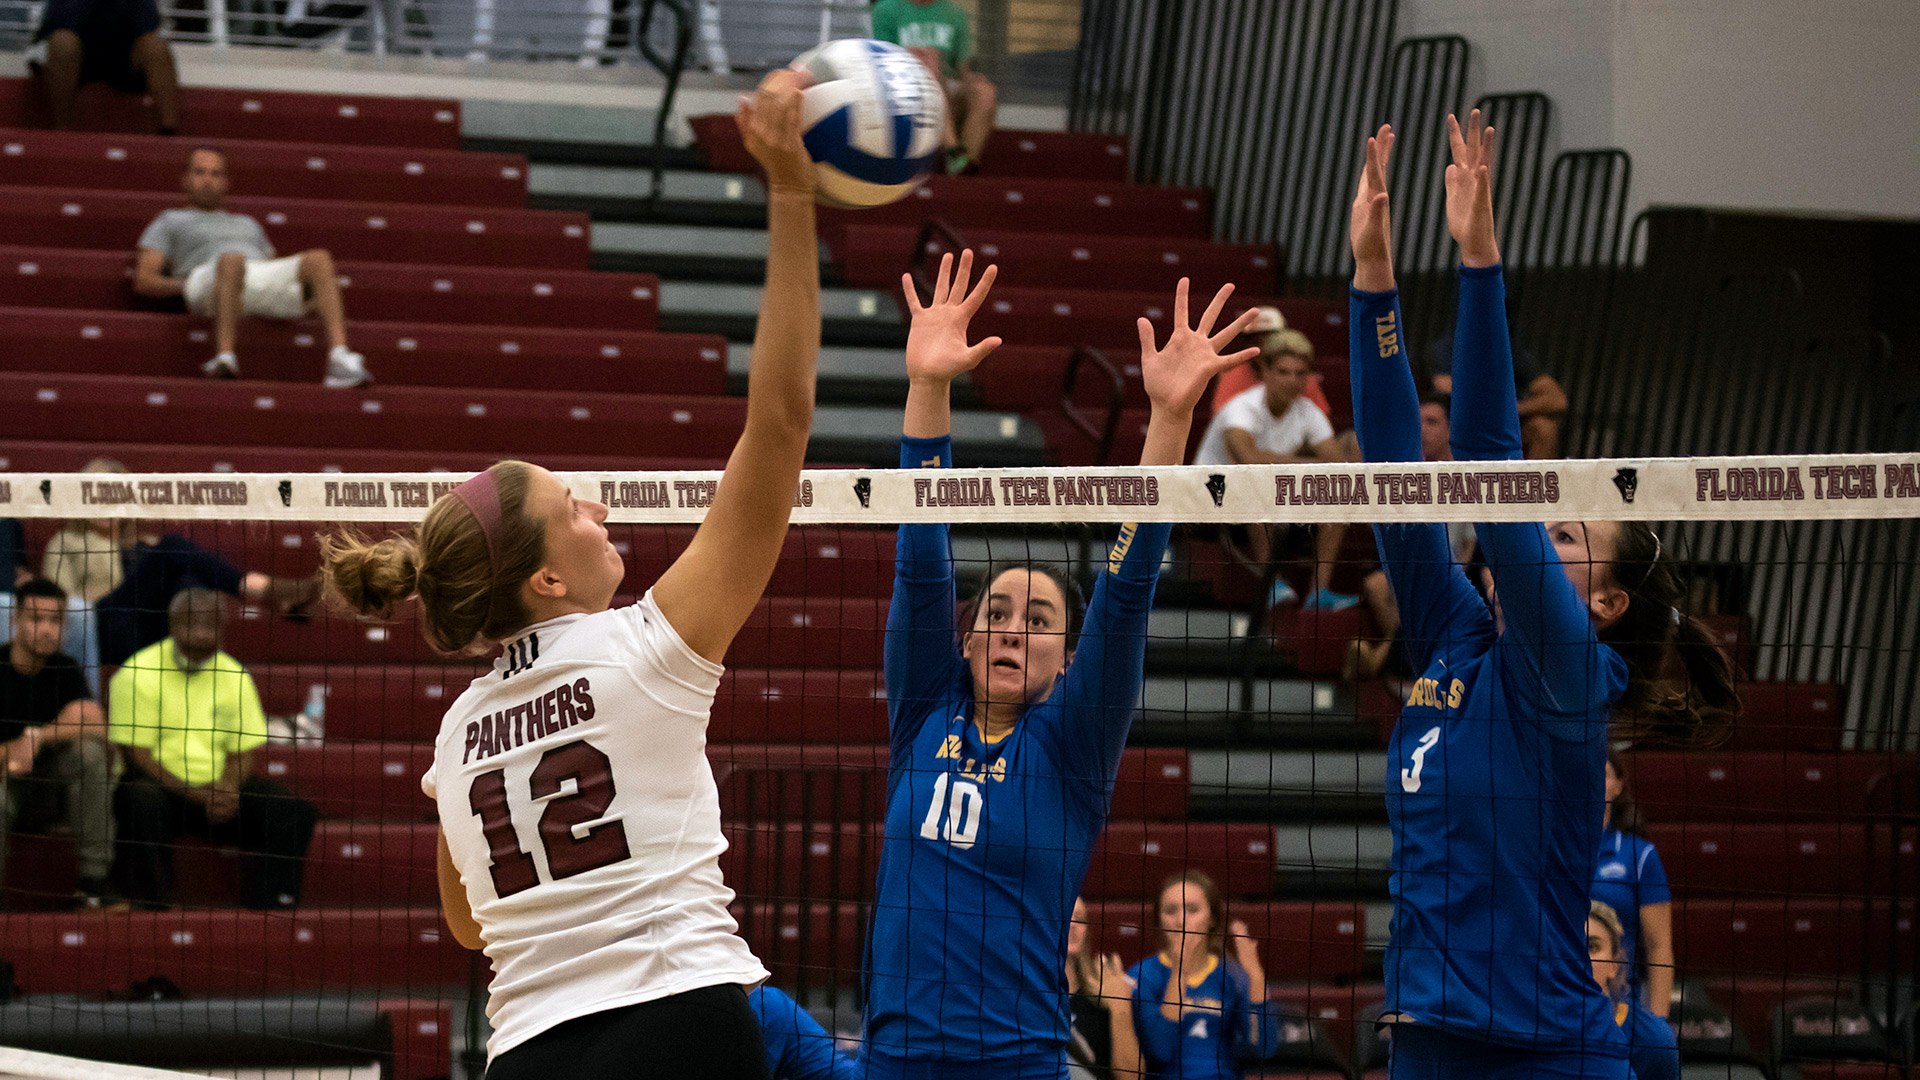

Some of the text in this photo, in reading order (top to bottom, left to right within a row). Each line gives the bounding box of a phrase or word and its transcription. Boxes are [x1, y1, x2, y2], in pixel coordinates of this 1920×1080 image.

[1376, 310, 1399, 358] TARS
[325, 482, 387, 507] FLORIDA
[391, 482, 429, 508] TECH
[600, 481, 671, 507] FLORIDA
[914, 476, 1159, 507] FLORIDA TECH PANTHERS
[1275, 471, 1560, 505] FLORIDA TECH PANTHERS
[1696, 468, 1805, 501] FLORIDA
[1809, 465, 1877, 499] TECH
[462, 677, 596, 765] PANTHERS
[1401, 726, 1441, 793] 3
[469, 739, 632, 900] 12
[920, 771, 984, 850] 10
